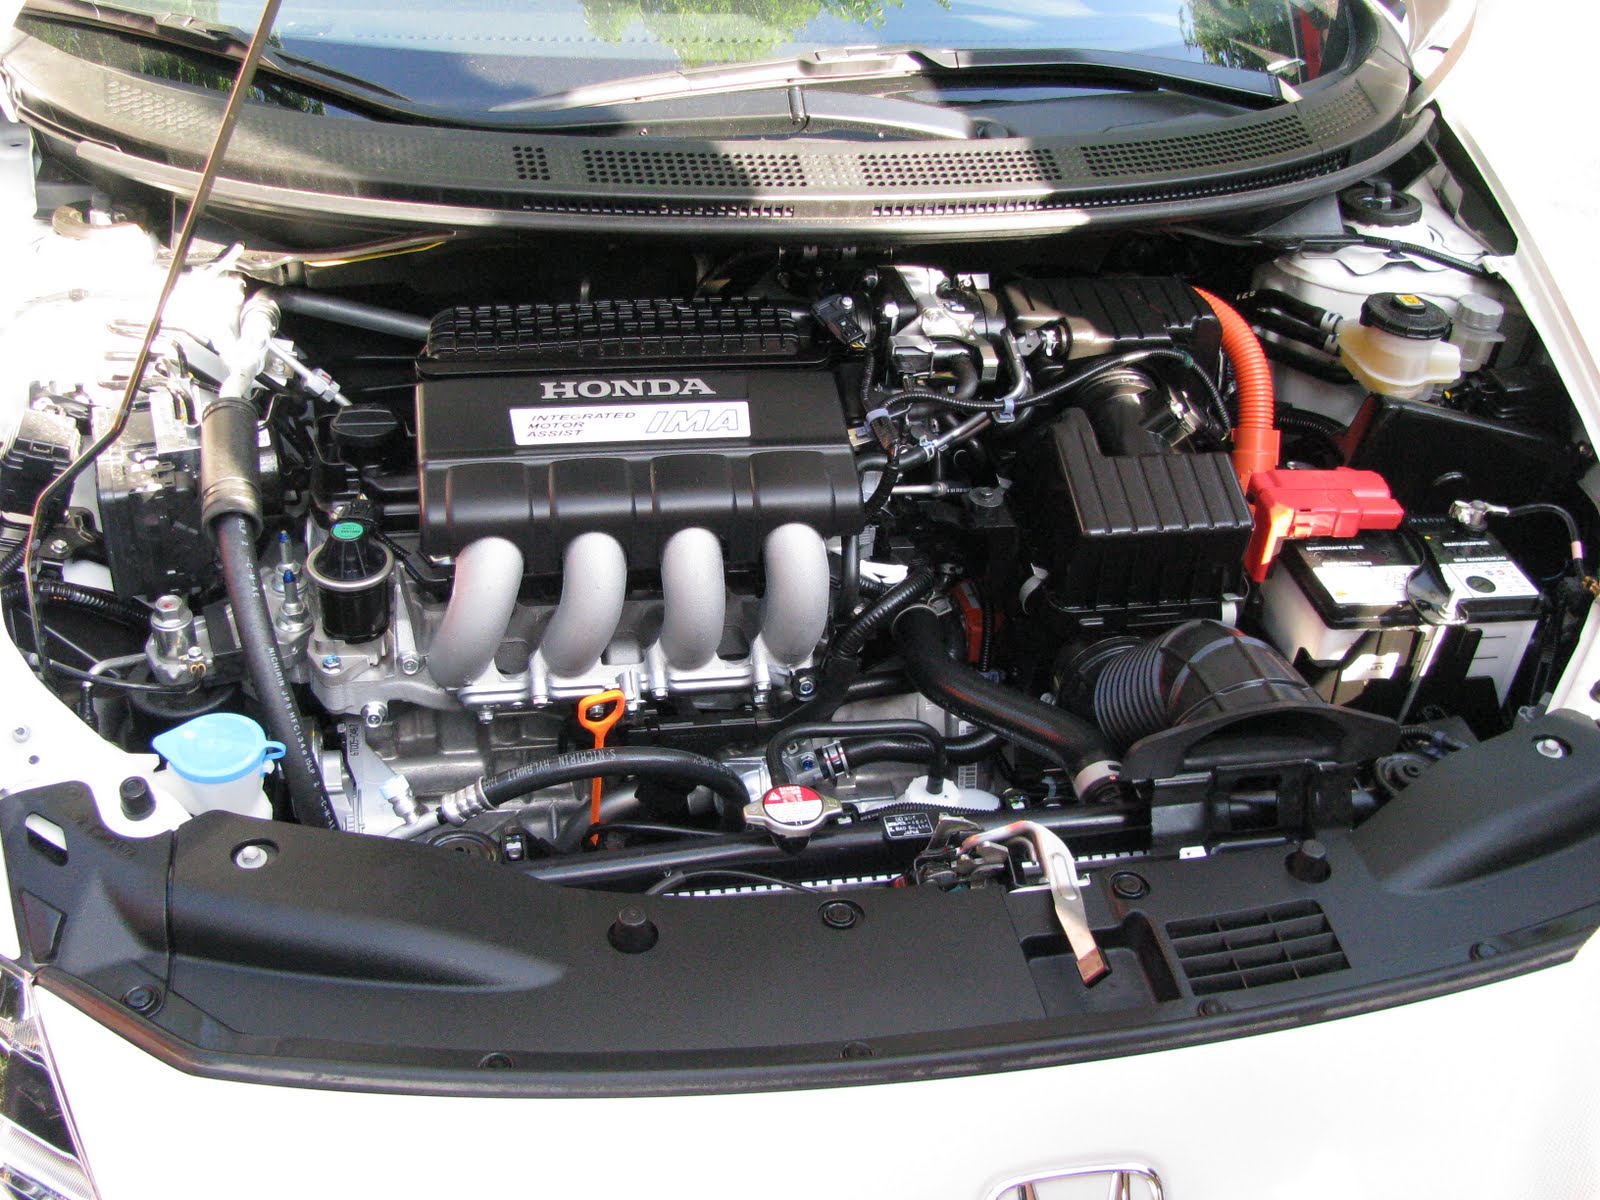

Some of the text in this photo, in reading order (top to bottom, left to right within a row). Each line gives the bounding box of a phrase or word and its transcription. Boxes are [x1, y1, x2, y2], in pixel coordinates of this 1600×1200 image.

[540, 378, 717, 400] HONDA
[531, 411, 636, 422] INTEGRATED
[646, 408, 739, 434] IMA
[528, 421, 585, 430] MOTOR
[527, 430, 584, 438] ASSIST
[268, 647, 285, 687] NICHIRIN
[281, 690, 293, 710] JPN
